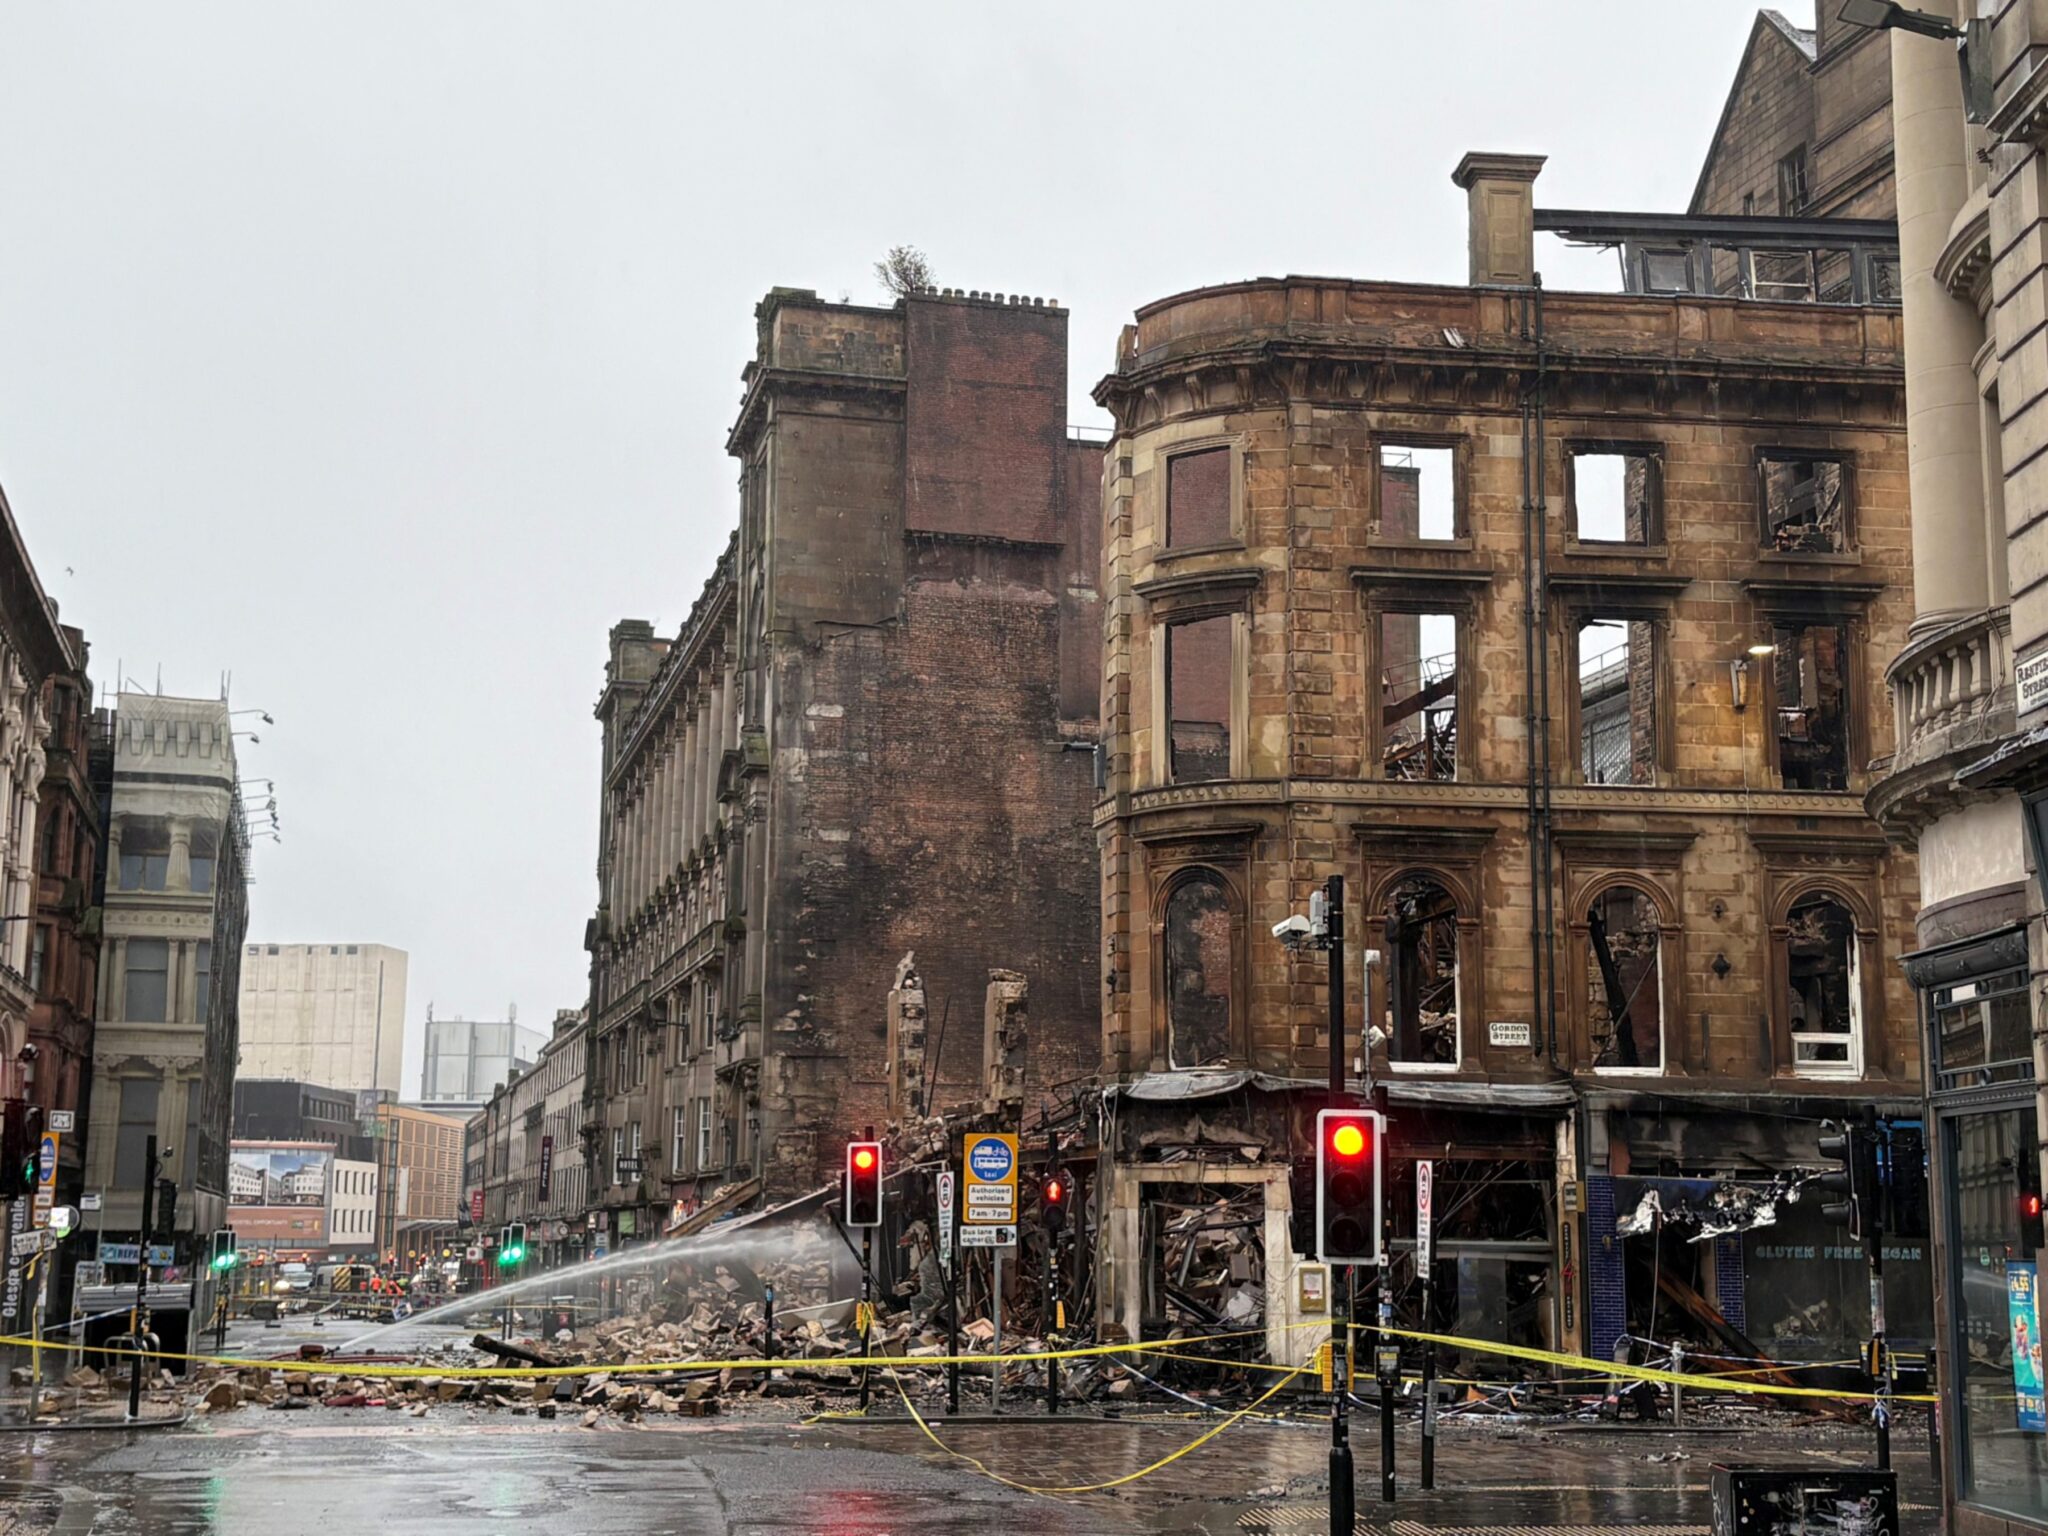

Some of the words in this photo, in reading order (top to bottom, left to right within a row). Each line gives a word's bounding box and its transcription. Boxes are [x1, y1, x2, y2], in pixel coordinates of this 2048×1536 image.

[1491, 1023, 1528, 1031] GORDON
[1493, 1032, 1527, 1040] STREET
[542, 1147, 551, 1188] HOTEL
[619, 1160, 638, 1169] HOTEL
[1755, 1246, 1815, 1260] GLUTEN
[1824, 1246, 1864, 1260] FREE
[1881, 1247, 1921, 1260] EGAN
